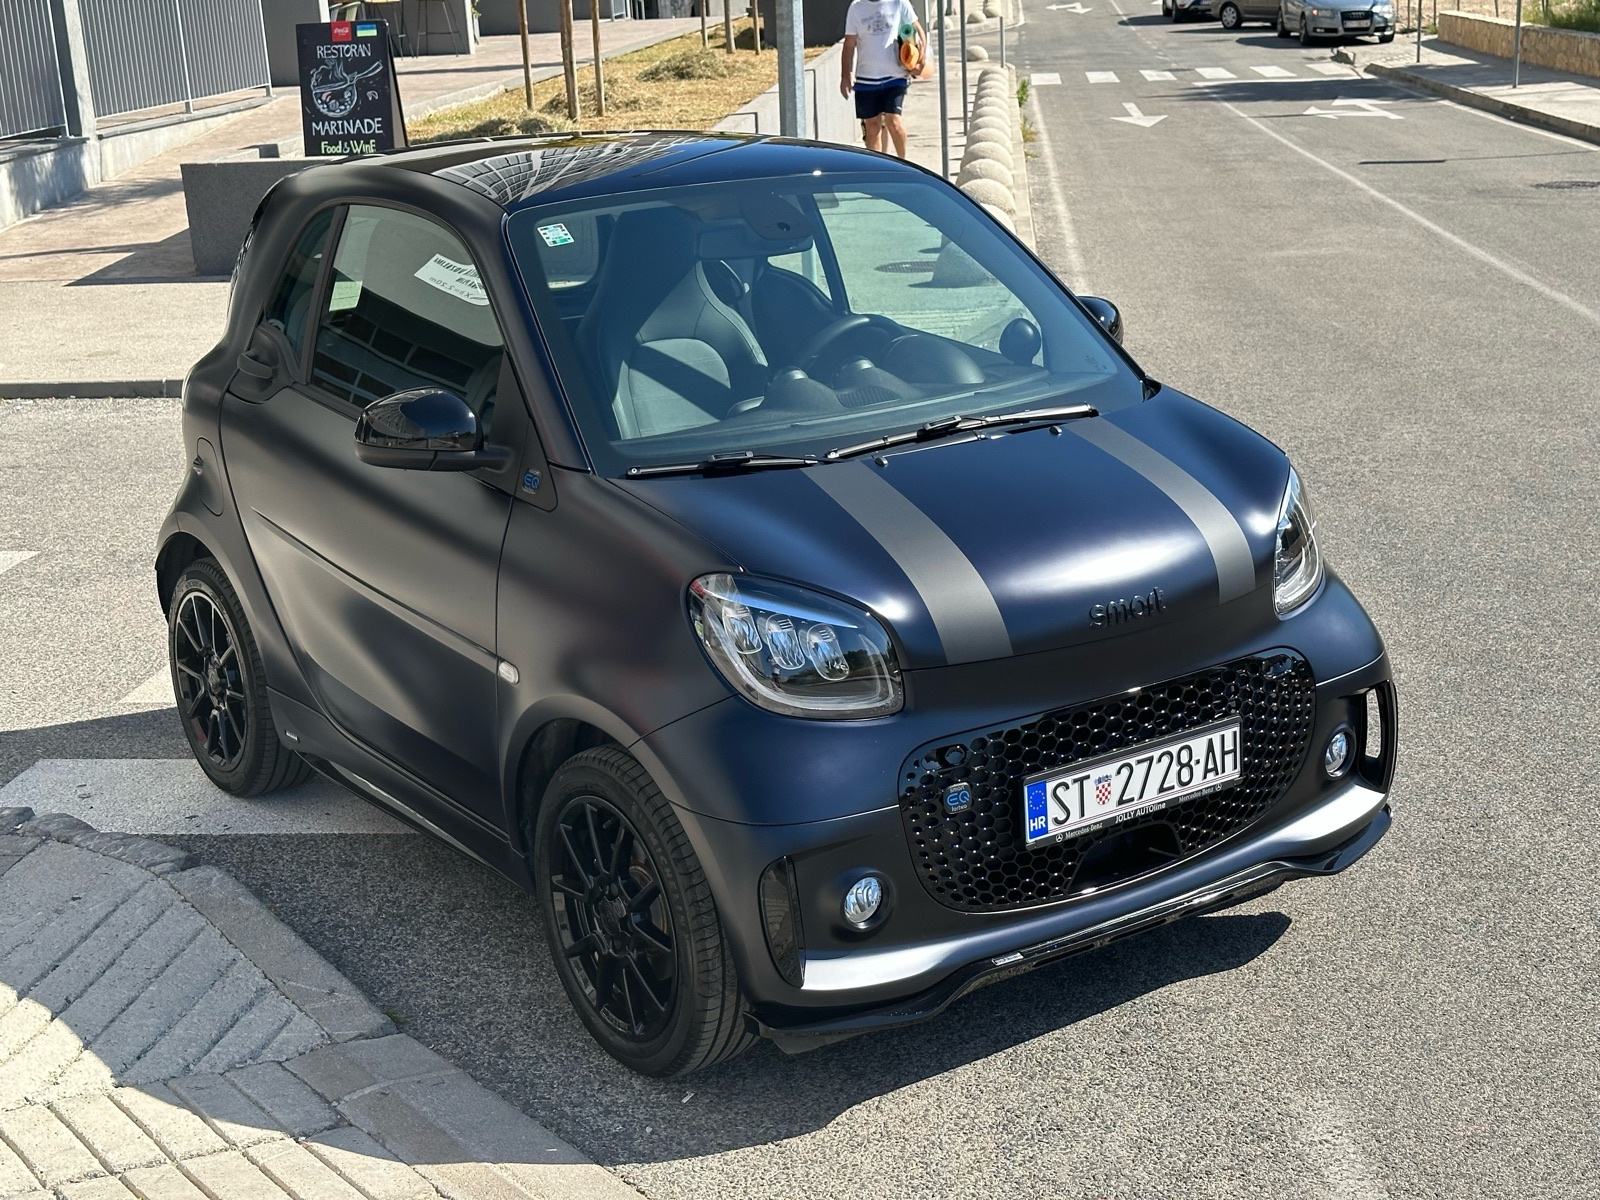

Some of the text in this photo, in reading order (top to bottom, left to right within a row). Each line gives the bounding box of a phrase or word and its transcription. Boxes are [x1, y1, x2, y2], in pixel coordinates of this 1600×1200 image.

[316, 44, 371, 59] RESTORAN
[312, 117, 383, 136] MARINADE
[321, 140, 341, 154] Food
[342, 142, 350, 154] &
[1088, 586, 1165, 627] smart
[947, 791, 969, 805] EQ
[1051, 774, 1091, 825] ST
[1115, 802, 1166, 824] JOLLY AUTOline
[1030, 815, 1046, 832] HR
